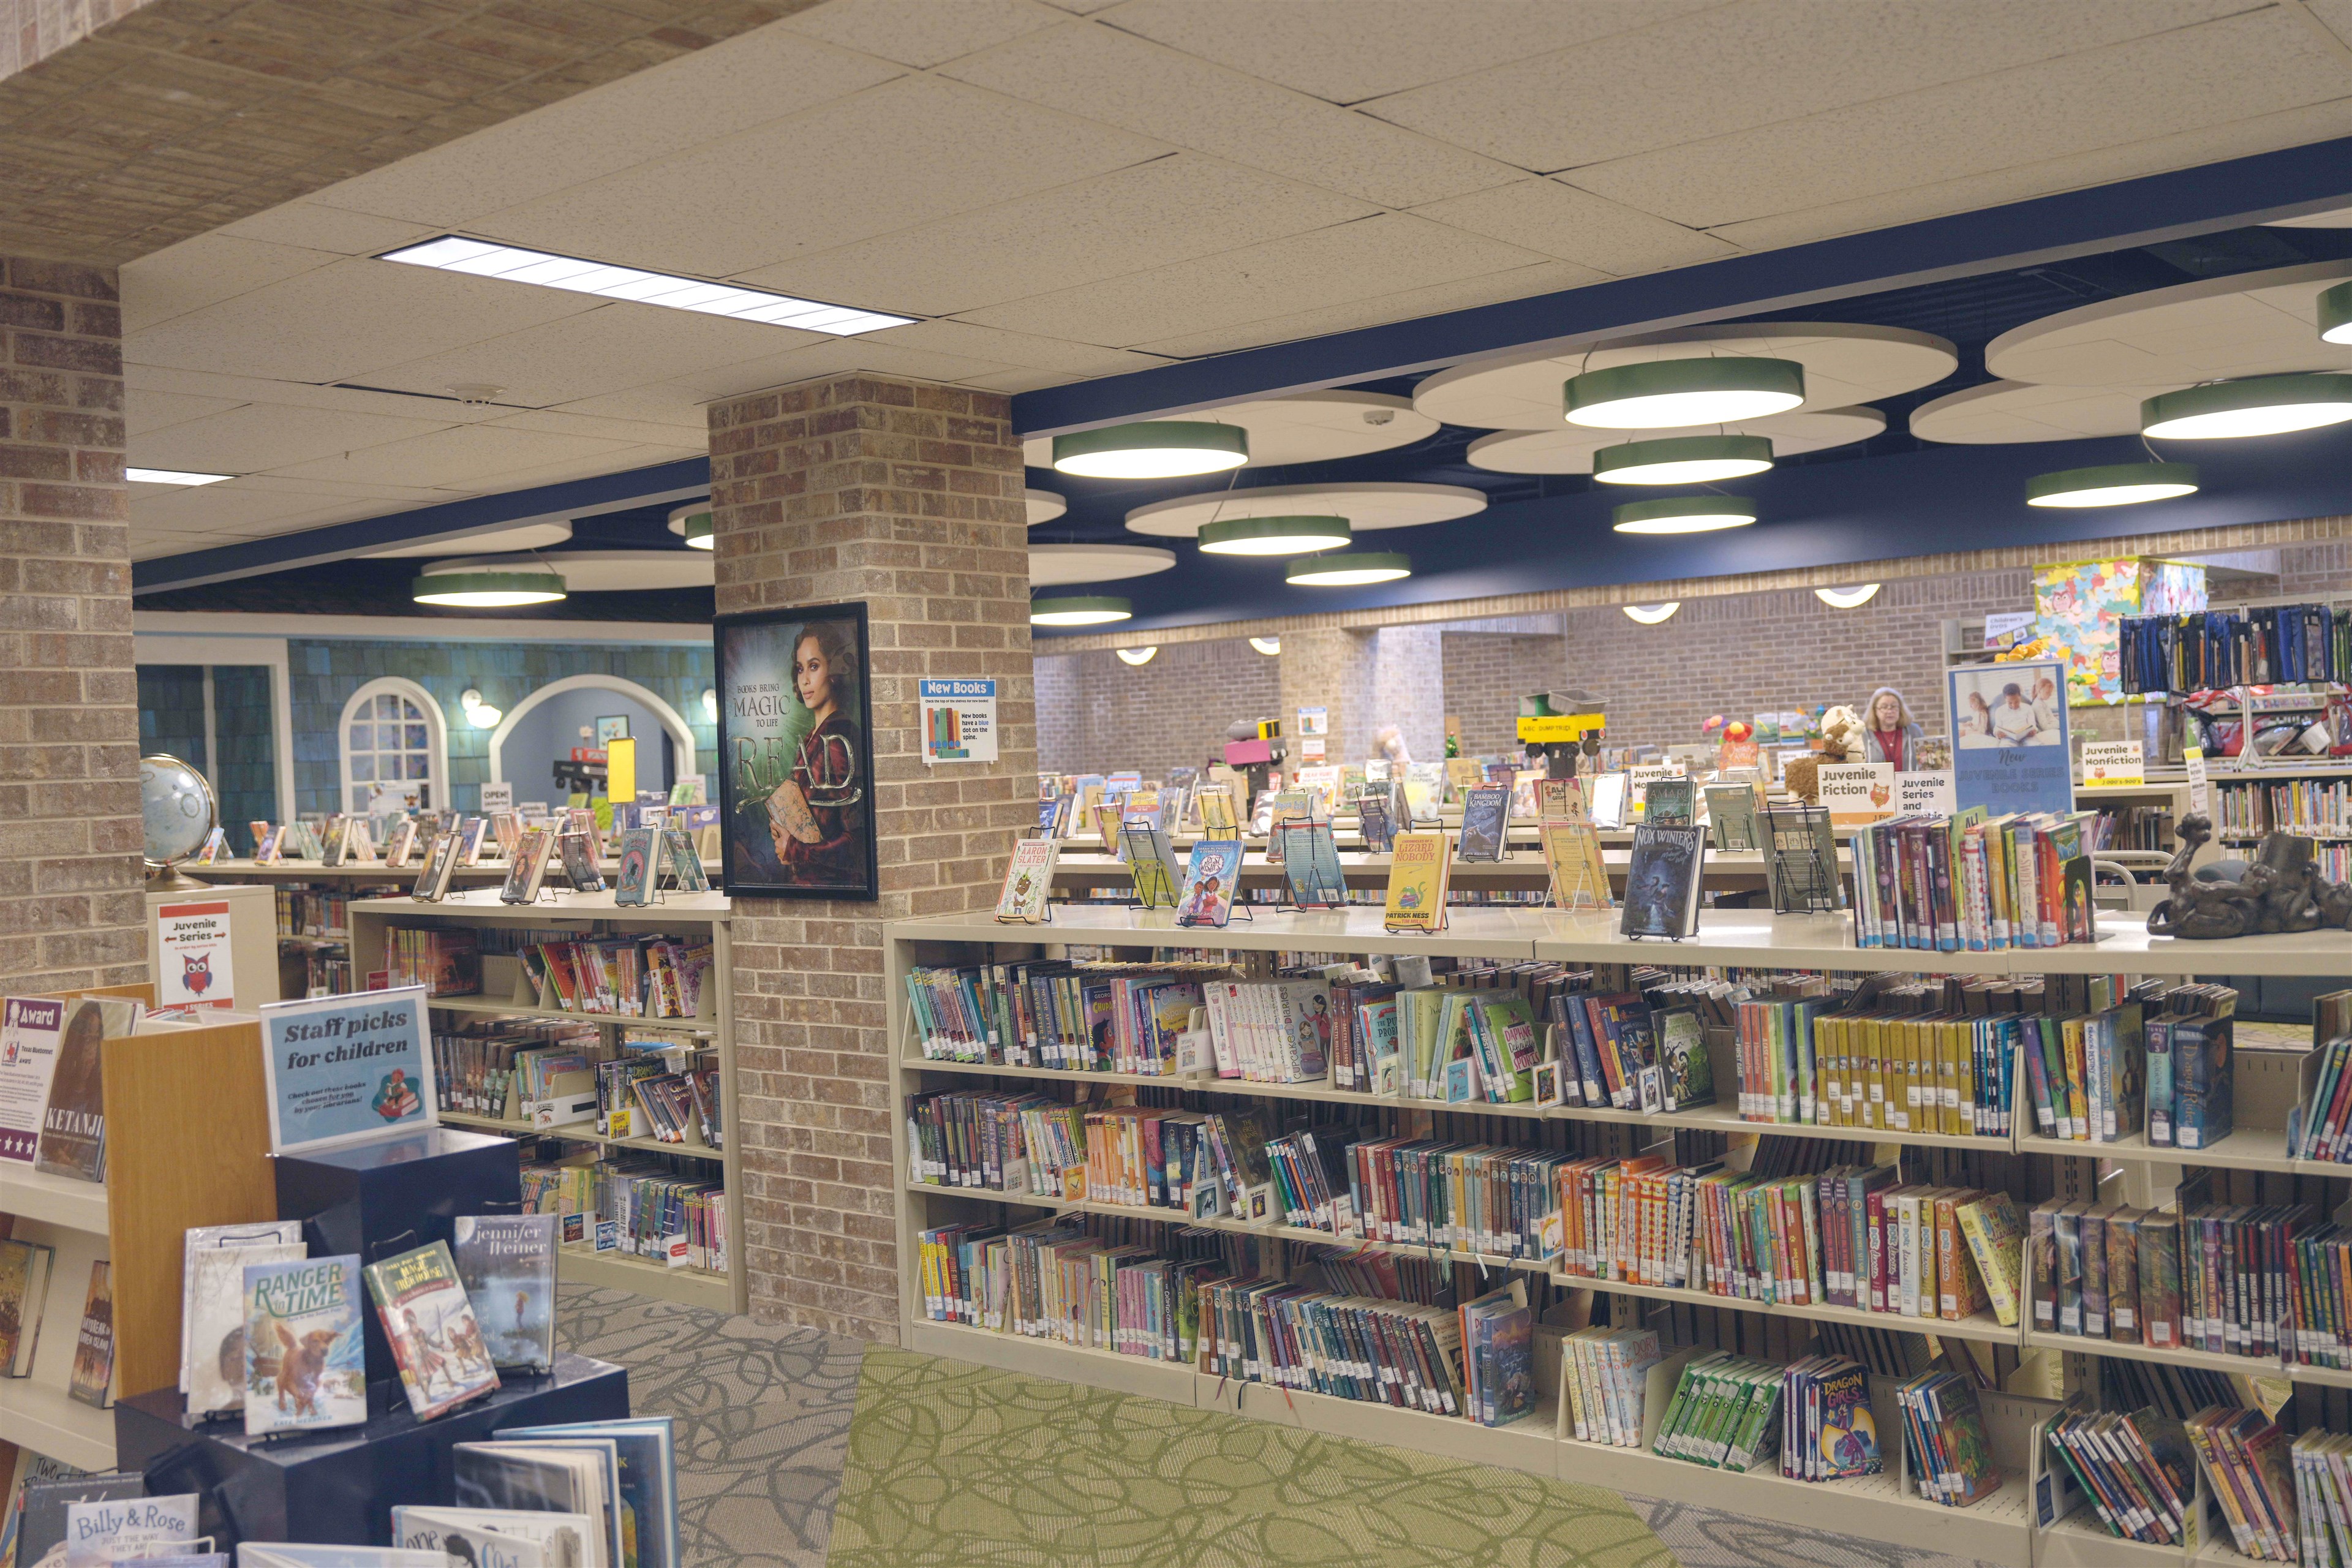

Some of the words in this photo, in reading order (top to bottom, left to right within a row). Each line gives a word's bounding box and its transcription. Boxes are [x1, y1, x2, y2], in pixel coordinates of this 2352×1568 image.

[737, 685, 756, 693] BOOKS
[760, 684, 779, 692] BRING
[928, 682, 951, 694] New
[954, 682, 987, 694] Books
[733, 695, 790, 717] MAGIC
[1999, 749, 2026, 766] New
[2085, 745, 2128, 755] Juvenile
[733, 734, 855, 790] READ
[2086, 756, 2141, 765] Nonfiction
[1634, 767, 1672, 778] Juvenile
[1822, 767, 1876, 781] Juvenile
[1959, 768, 2017, 782] JUVENILE
[2022, 766, 2064, 780] SERIES
[1822, 783, 1868, 795] Fiction
[1902, 777, 1945, 788] Juvenile
[1992, 782, 2039, 794] BOOKS
[1469, 799, 1502, 808] KINGDOM
[1649, 789, 1686, 799] AMARI
[1902, 790, 1934, 799] Series
[1635, 829, 1655, 849] NOX
[1657, 829, 1696, 854] WINTERS
[1200, 862, 1220, 872] WISHES
[1395, 853, 1435, 862] NOBODY
[173, 919, 216, 930] Juvenile
[179, 932, 211, 941] Series
[20, 1006, 55, 1025] Award
[284, 1017, 346, 1043] Staff
[346, 1011, 407, 1039] picks
[1504, 1025, 1532, 1042] DAPHNE
[287, 1052, 321, 1069] for
[325, 1039, 408, 1063] children
[1513, 1052, 1540, 1071] SPORTS
[288, 1091, 309, 1099] Check
[345, 1082, 366, 1090] books
[301, 1095, 328, 1104] chosen
[45, 1108, 104, 1137] KETANJI
[474, 1224, 541, 1245] jennifer
[1869, 1227, 1880, 1251] DORK
[1888, 1224, 1898, 1246] DORK
[1921, 1226, 1931, 1248] DORK
[1940, 1229, 1950, 1251] DORK
[490, 1241, 547, 1255] Weiner
[401, 1260, 429, 1277] MAGIC
[919, 1244, 928, 1278] CLUELESS
[1871, 1251, 1881, 1278] diaries
[1888, 1246, 1899, 1275] diaries
[1902, 1249, 1911, 1276] diaries
[1921, 1247, 1931, 1278] diaries
[1941, 1251, 1951, 1281] diaries
[1970, 1237, 1984, 1256] DORK
[1980, 1259, 1993, 1287] diaries
[254, 1262, 343, 1312] RANGER
[284, 1283, 343, 1313] TIME
[93, 1336, 109, 1351] ISLAND
[1632, 1336, 1657, 1355] DORY
[1566, 1362, 1575, 1381] DORY
[1579, 1363, 1588, 1382] DORY
[1823, 1372, 1863, 1395] DRAGON
[1827, 1387, 1860, 1408] GIRLS
[36, 1457, 58, 1479] TWO
[76, 1509, 124, 1540] Billy
[127, 1508, 141, 1526] &
[145, 1505, 186, 1532] Rose
[142, 1532, 160, 1541] WAY
[111, 1544, 132, 1553] THEY
